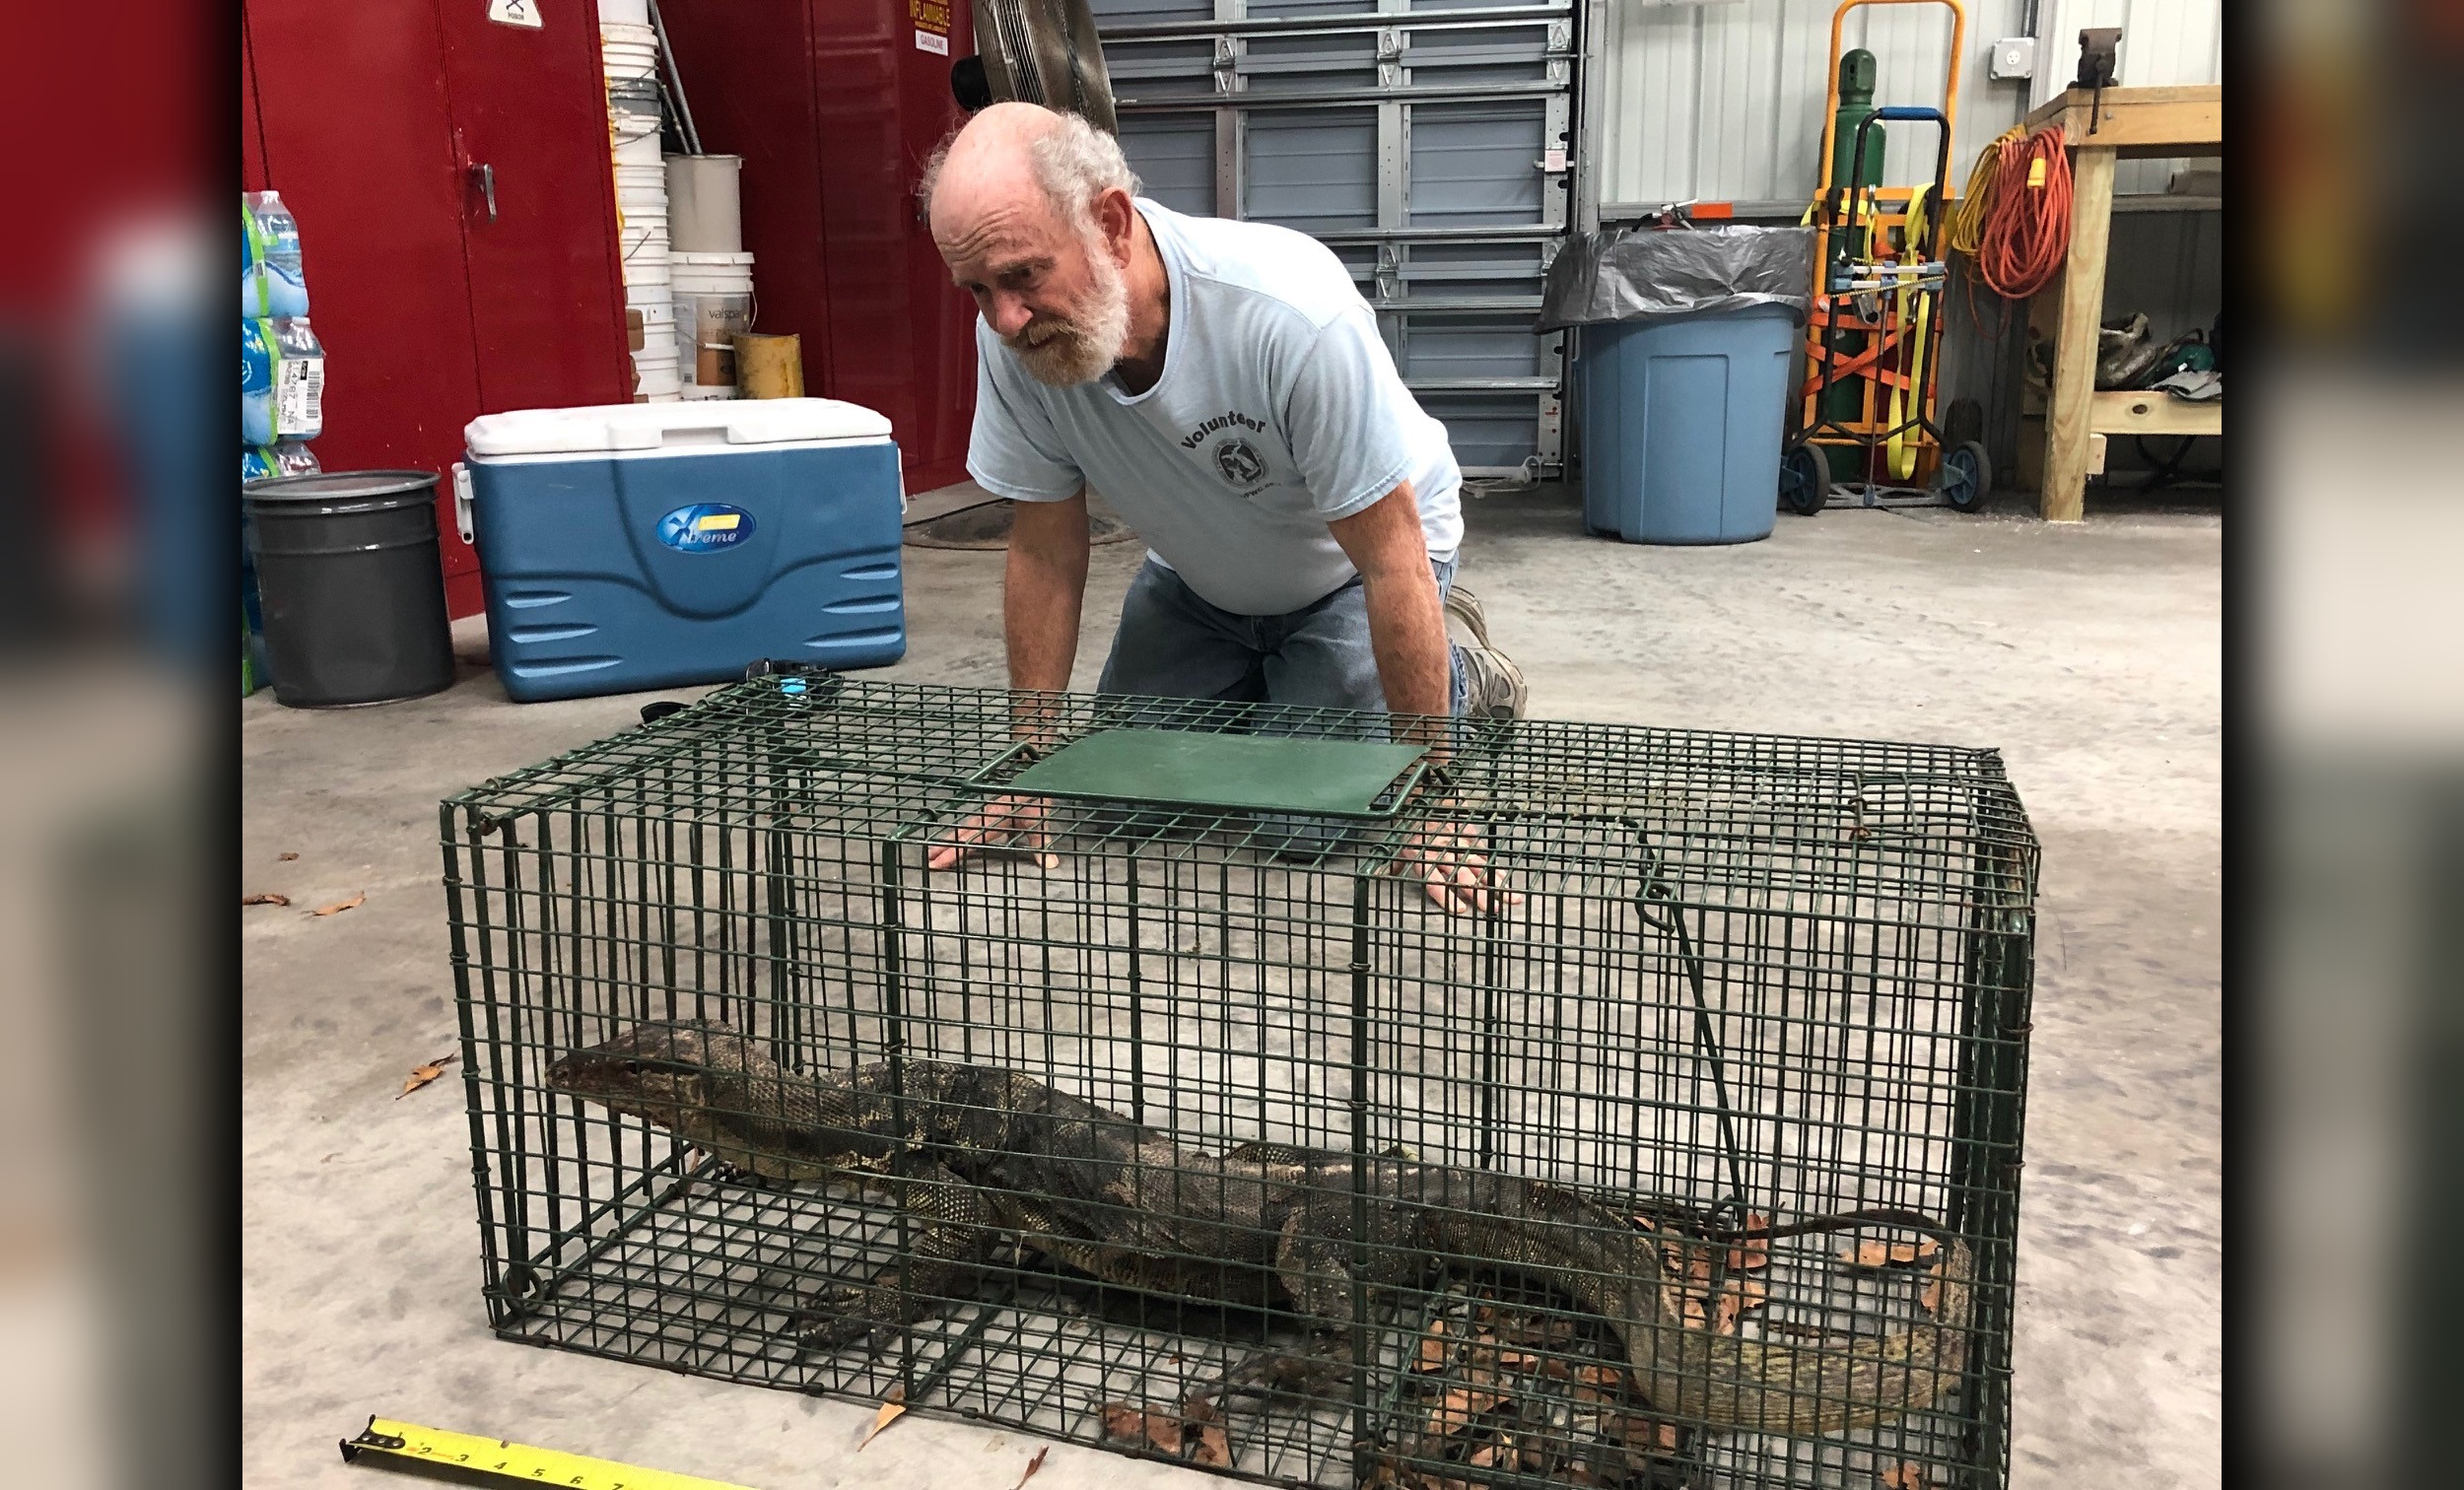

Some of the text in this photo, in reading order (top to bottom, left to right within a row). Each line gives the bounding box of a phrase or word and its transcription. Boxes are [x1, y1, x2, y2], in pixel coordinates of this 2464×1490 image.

[921, 34, 943, 49] GASOLINE
[1181, 410, 1266, 449] Volunteer
[455, 1454, 470, 1462] 3
[493, 1461, 509, 1471] 4
[530, 1468, 546, 1478] 5
[569, 1475, 584, 1485] 6
